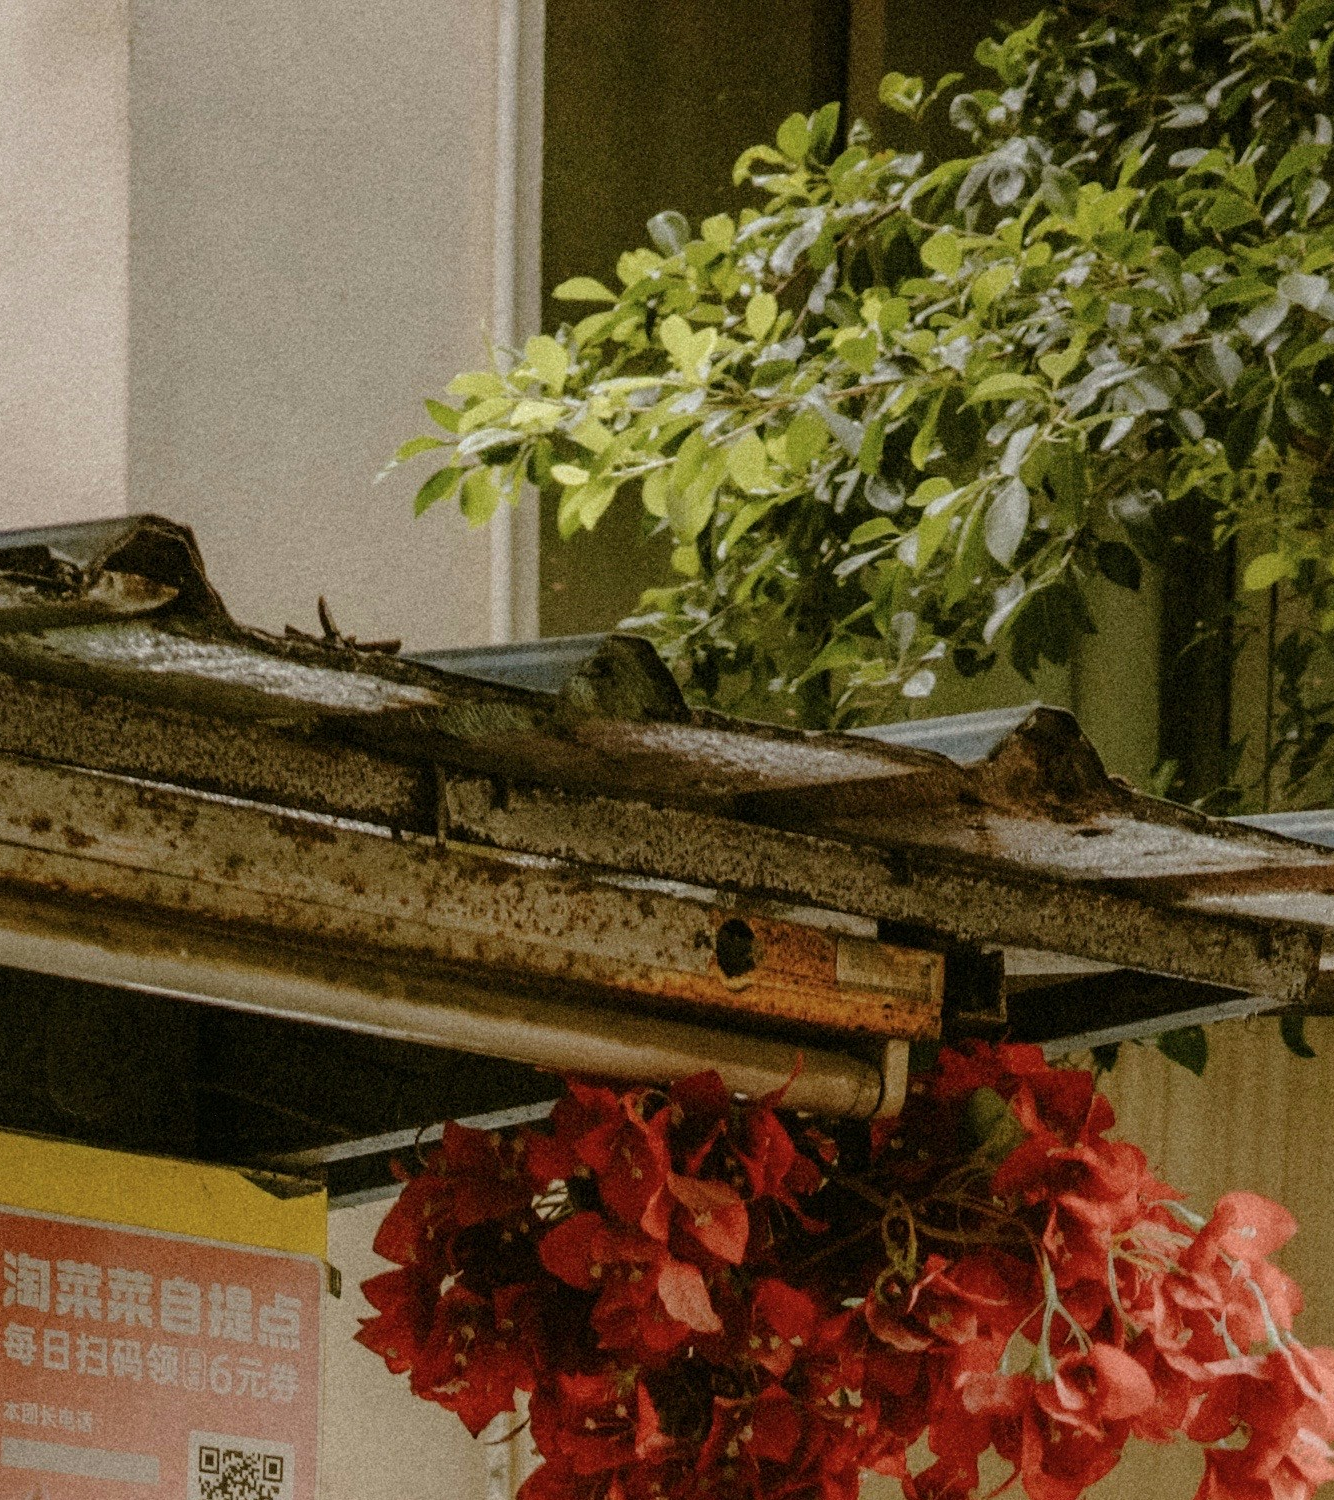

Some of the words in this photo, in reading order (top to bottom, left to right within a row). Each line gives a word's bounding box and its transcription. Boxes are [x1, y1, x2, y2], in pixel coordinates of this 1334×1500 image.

[3, 1250, 302, 1350] 淘菜菜自提点
